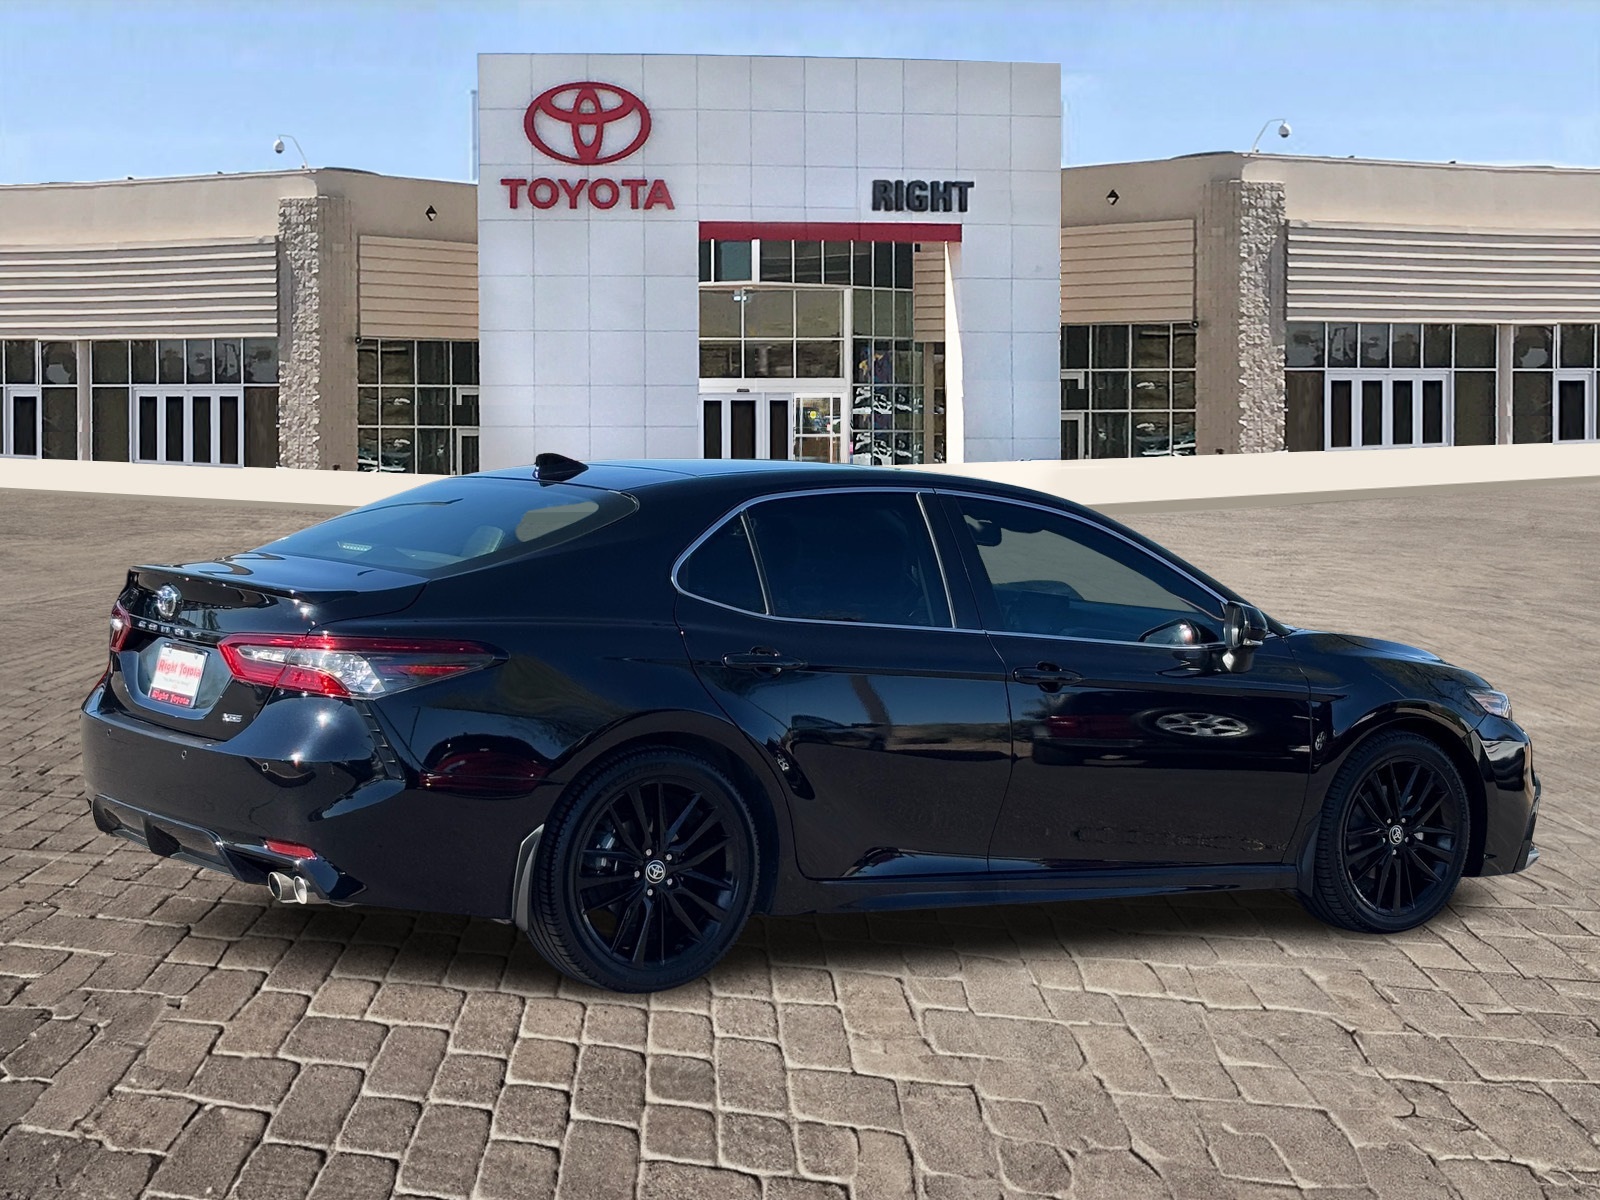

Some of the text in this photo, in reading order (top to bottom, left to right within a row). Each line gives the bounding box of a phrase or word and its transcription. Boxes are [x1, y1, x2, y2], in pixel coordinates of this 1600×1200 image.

[500, 177, 675, 210] TOYOTA
[871, 179, 975, 212] RIGHT
[158, 660, 202, 678] Right Toyota
[152, 689, 190, 705] Right Toyota
